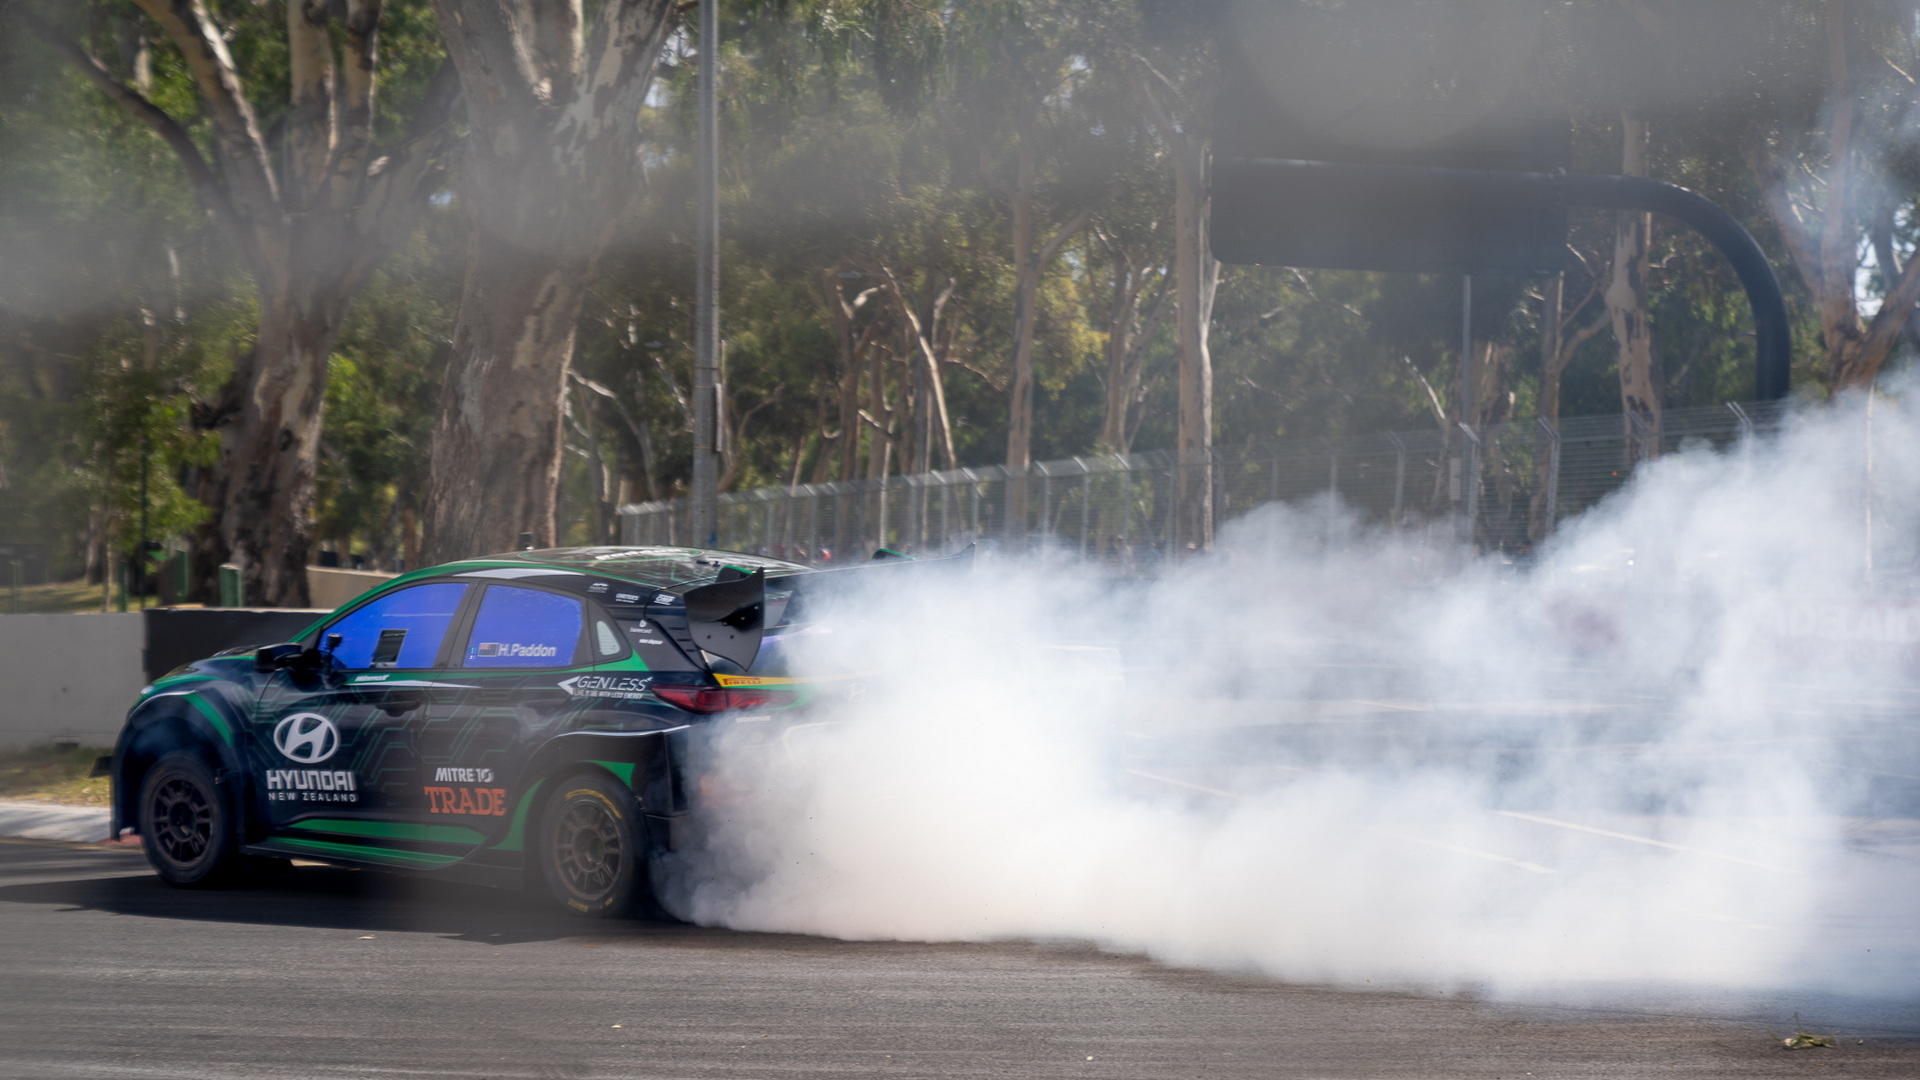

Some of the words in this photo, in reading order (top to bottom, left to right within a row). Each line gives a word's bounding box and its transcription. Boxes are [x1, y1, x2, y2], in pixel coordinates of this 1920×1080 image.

[498, 643, 556, 657] H.Paddon
[722, 677, 761, 686] PIRELLI
[266, 769, 356, 791] HYUNDAI
[435, 767, 474, 782] MITRE
[476, 768, 494, 783] 10
[268, 792, 298, 802] NEW
[302, 793, 357, 803] ZEALAND
[424, 786, 507, 816] TRADE
